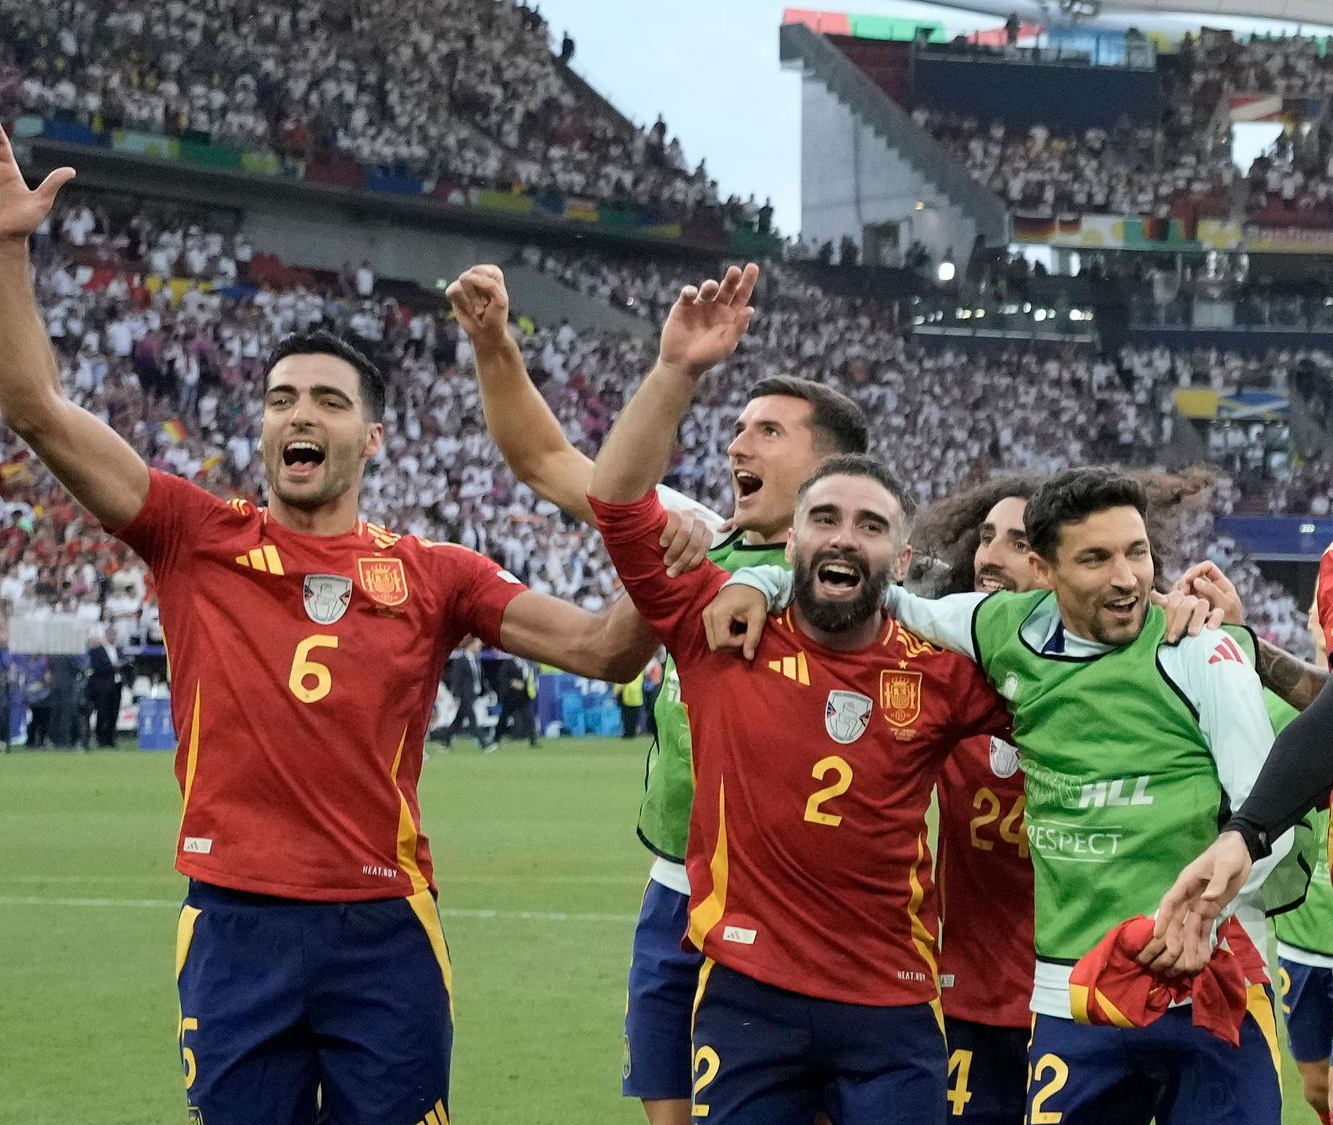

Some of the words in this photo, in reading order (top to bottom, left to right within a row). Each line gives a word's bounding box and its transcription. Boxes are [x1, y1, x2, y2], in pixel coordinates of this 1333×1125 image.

[289, 634, 338, 703] 6
[804, 756, 853, 827] 2
[970, 787, 1029, 859] 24
[691, 1045, 721, 1117] 2
[1027, 1053, 1069, 1125] 2
